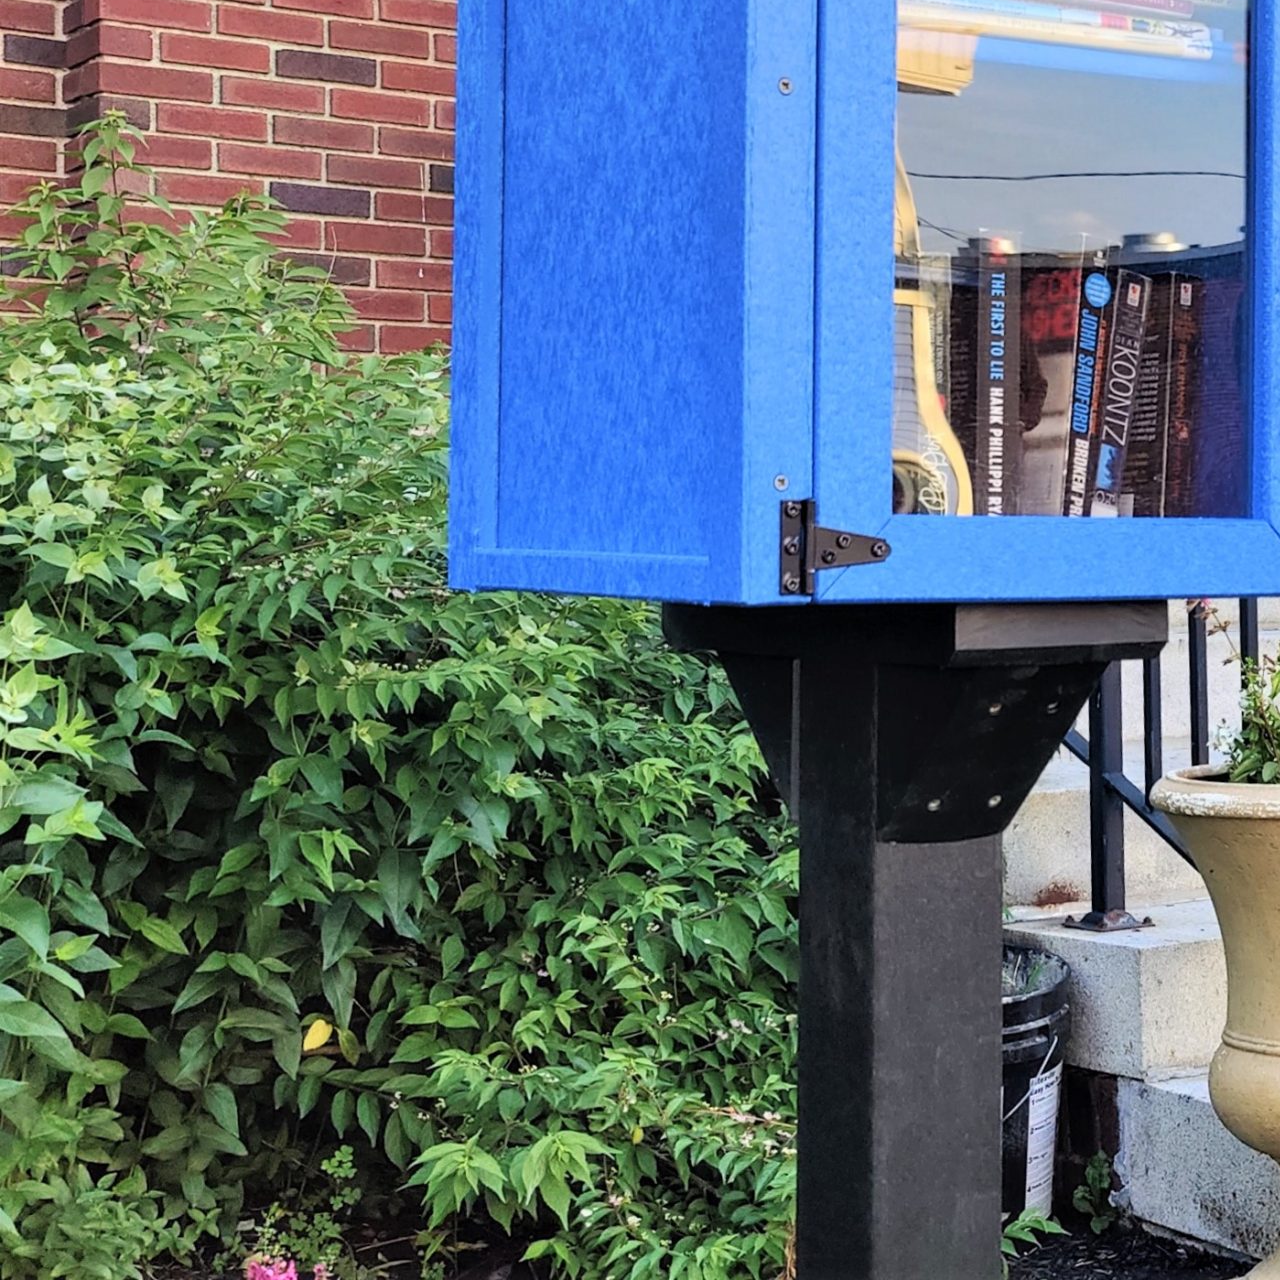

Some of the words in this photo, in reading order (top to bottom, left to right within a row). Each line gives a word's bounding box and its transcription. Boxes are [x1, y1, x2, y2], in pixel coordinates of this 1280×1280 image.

[991, 273, 1005, 297] THE
[990, 301, 1005, 336] FIRST
[1079, 308, 1099, 351] JOHN
[990, 341, 1004, 357] TO
[990, 361, 1004, 380] LIE
[989, 387, 1004, 425] HANK
[1072, 353, 1095, 433] SANDFORD
[1101, 344, 1141, 447] KOONTZ
[988, 428, 1003, 492] PHILLIPPI
[1070, 438, 1090, 495] BROKEN
[988, 496, 1003, 516] RY
[1068, 495, 1084, 517] PR
